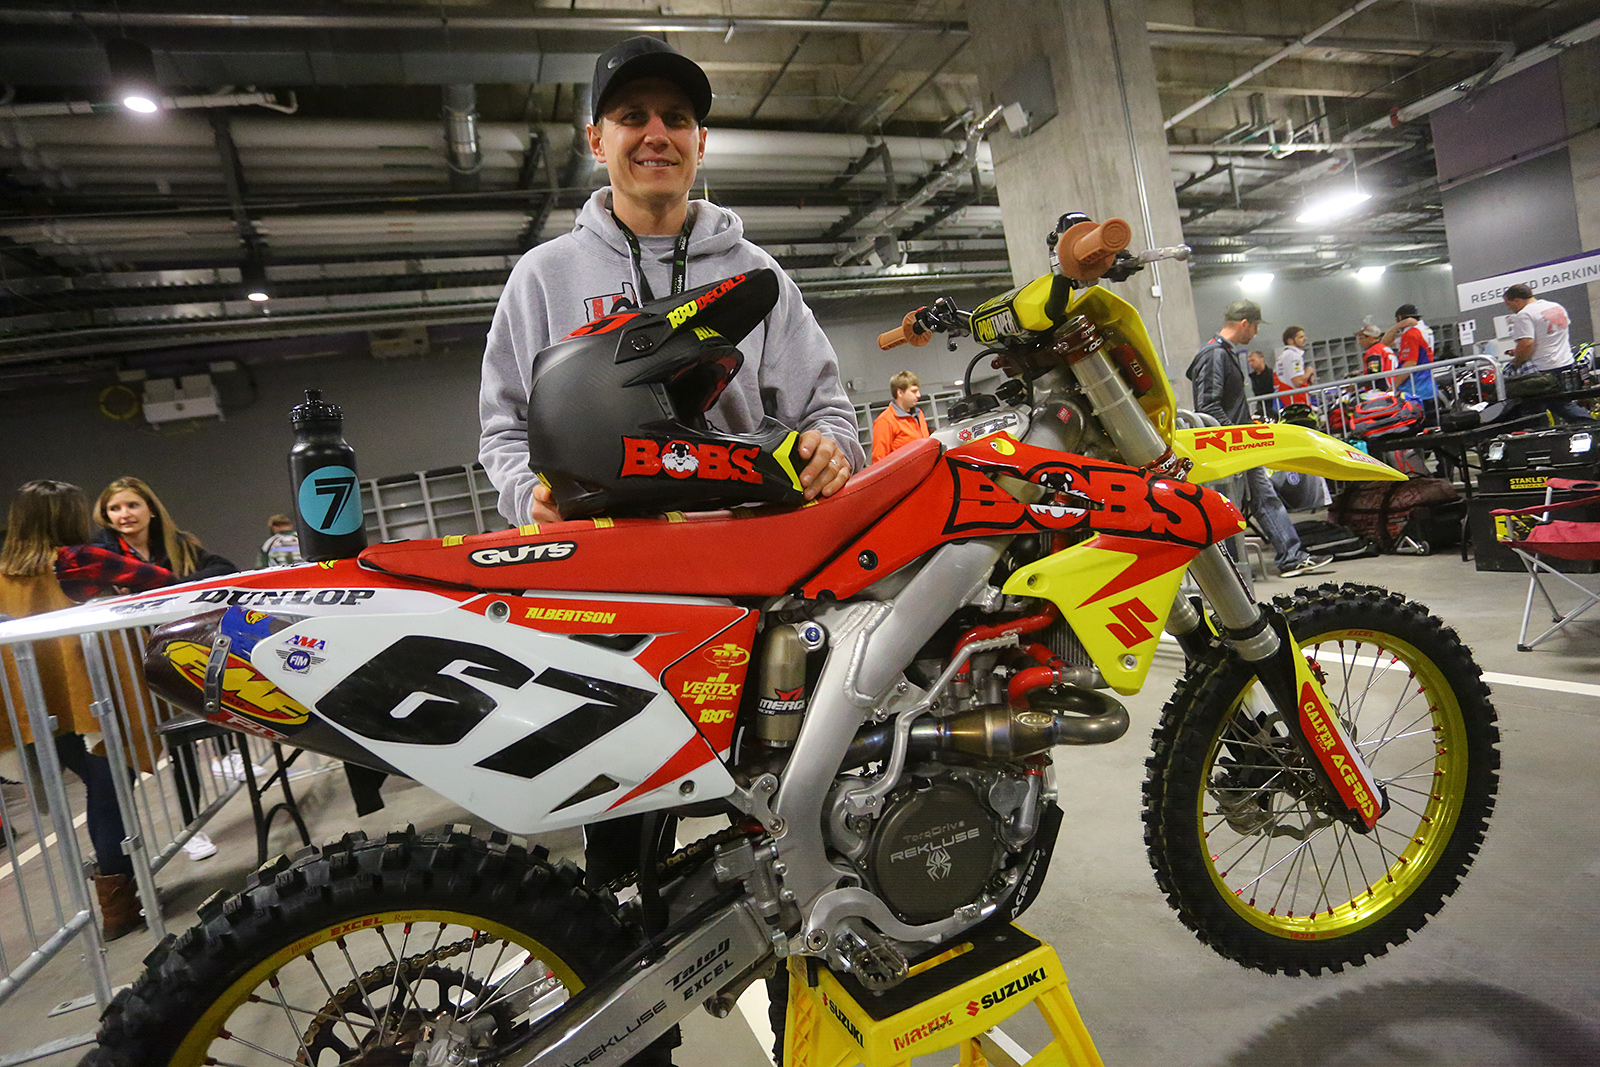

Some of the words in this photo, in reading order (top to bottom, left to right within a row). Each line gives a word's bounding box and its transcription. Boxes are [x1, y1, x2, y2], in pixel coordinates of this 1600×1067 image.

[1542, 264, 1600, 287] PARKIN
[1193, 425, 1274, 453] RTC
[1228, 440, 1275, 452] REYNARD
[1509, 476, 1548, 485] STANLEY
[315, 476, 356, 530] 7
[471, 542, 575, 564] GUTS
[190, 589, 375, 605] DUNLOP
[524, 607, 617, 626] ALBERTSON
[285, 635, 326, 650] AMA
[290, 655, 308, 666] FIM
[682, 681, 742, 696] VERTEX
[315, 634, 659, 780] 67
[1303, 701, 1336, 751] GALFER
[1331, 754, 1375, 818] ACERBIS
[889, 827, 980, 864] REKLUSE
[1010, 849, 1041, 920] ACERBIS
[330, 916, 384, 937] EXCEL
[682, 959, 734, 1001] EXCEL
[981, 967, 1047, 1010] SUZUKI
[572, 1000, 668, 1067] REKLUSE
[829, 1000, 865, 1049] SUZUKI
[893, 1012, 954, 1052] Matrix
